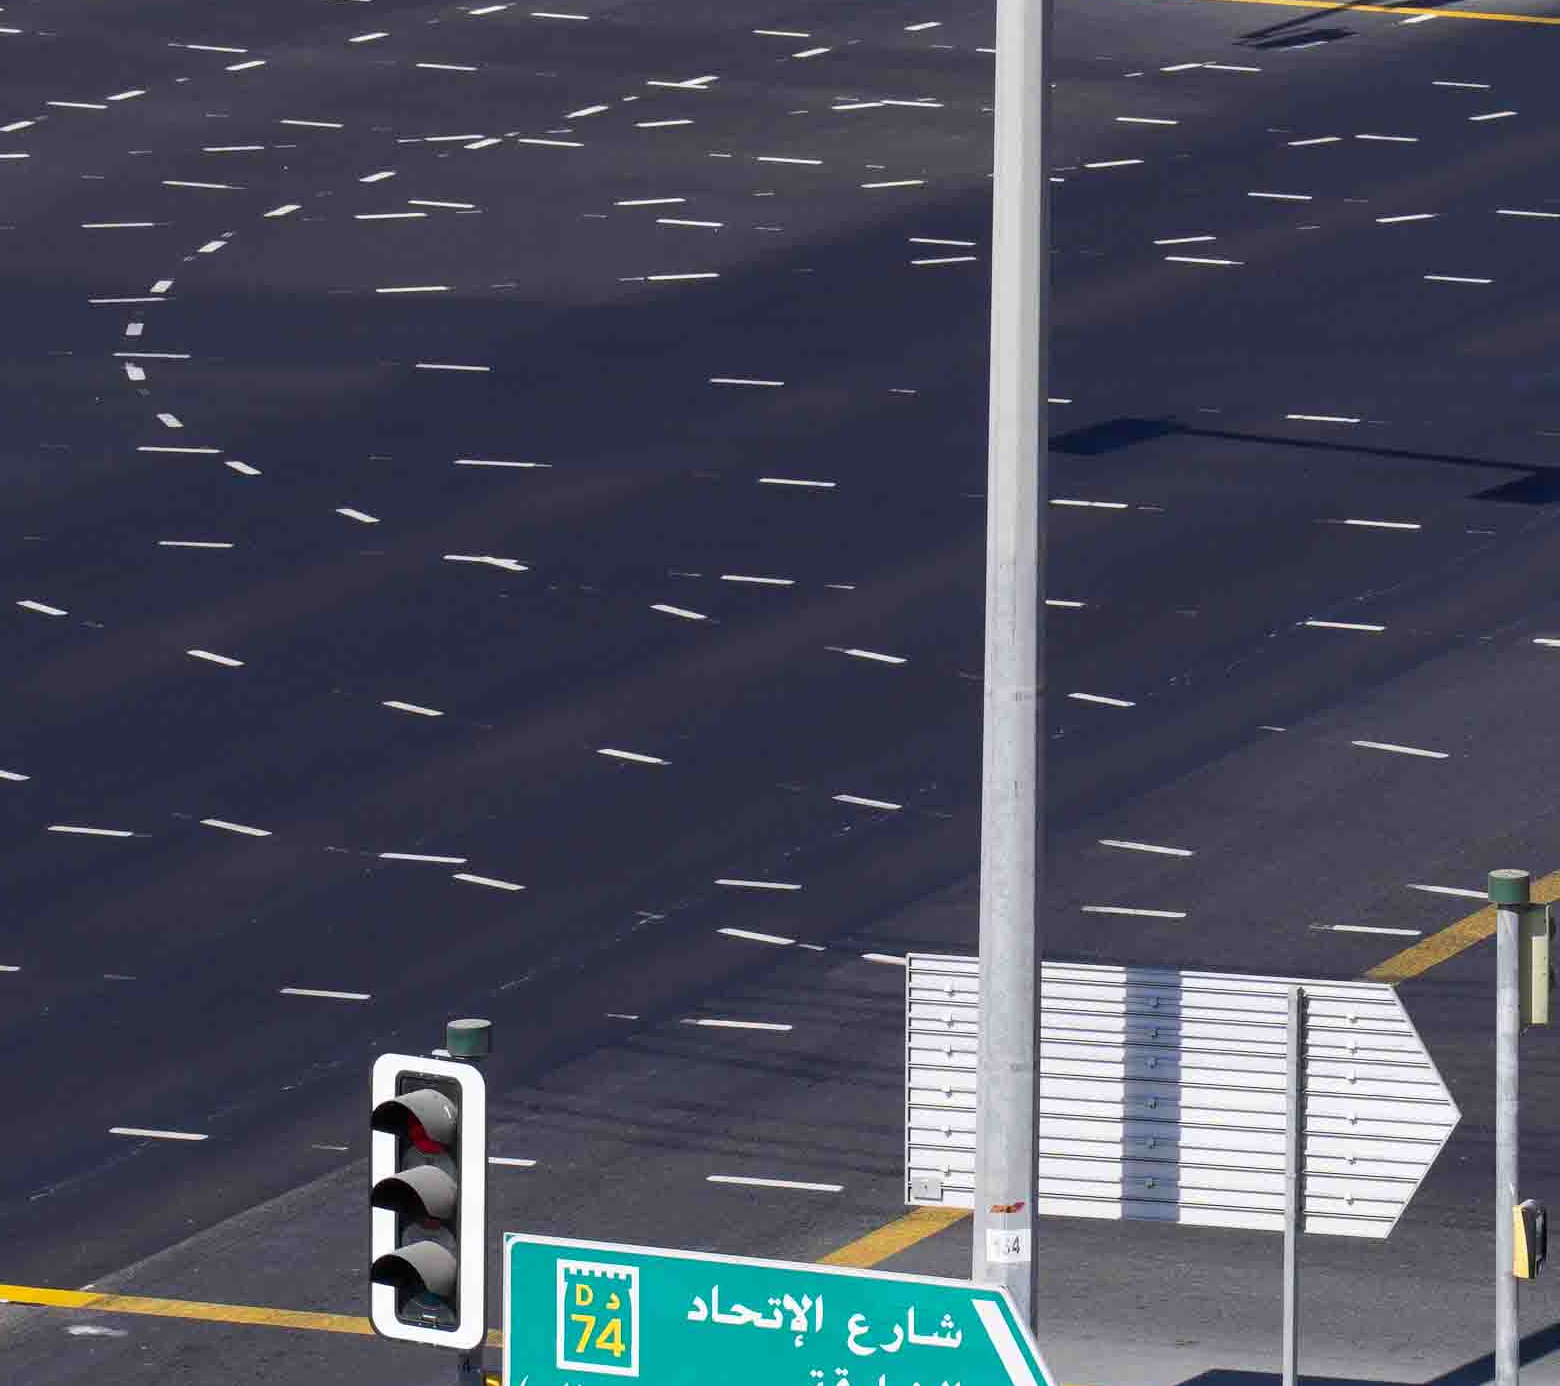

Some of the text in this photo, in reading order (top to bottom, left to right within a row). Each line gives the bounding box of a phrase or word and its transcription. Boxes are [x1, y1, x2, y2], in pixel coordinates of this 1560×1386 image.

[575, 1283, 594, 1307] D
[570, 1313, 626, 1358] 74
[687, 1284, 963, 1356] شارع الإتحاد
